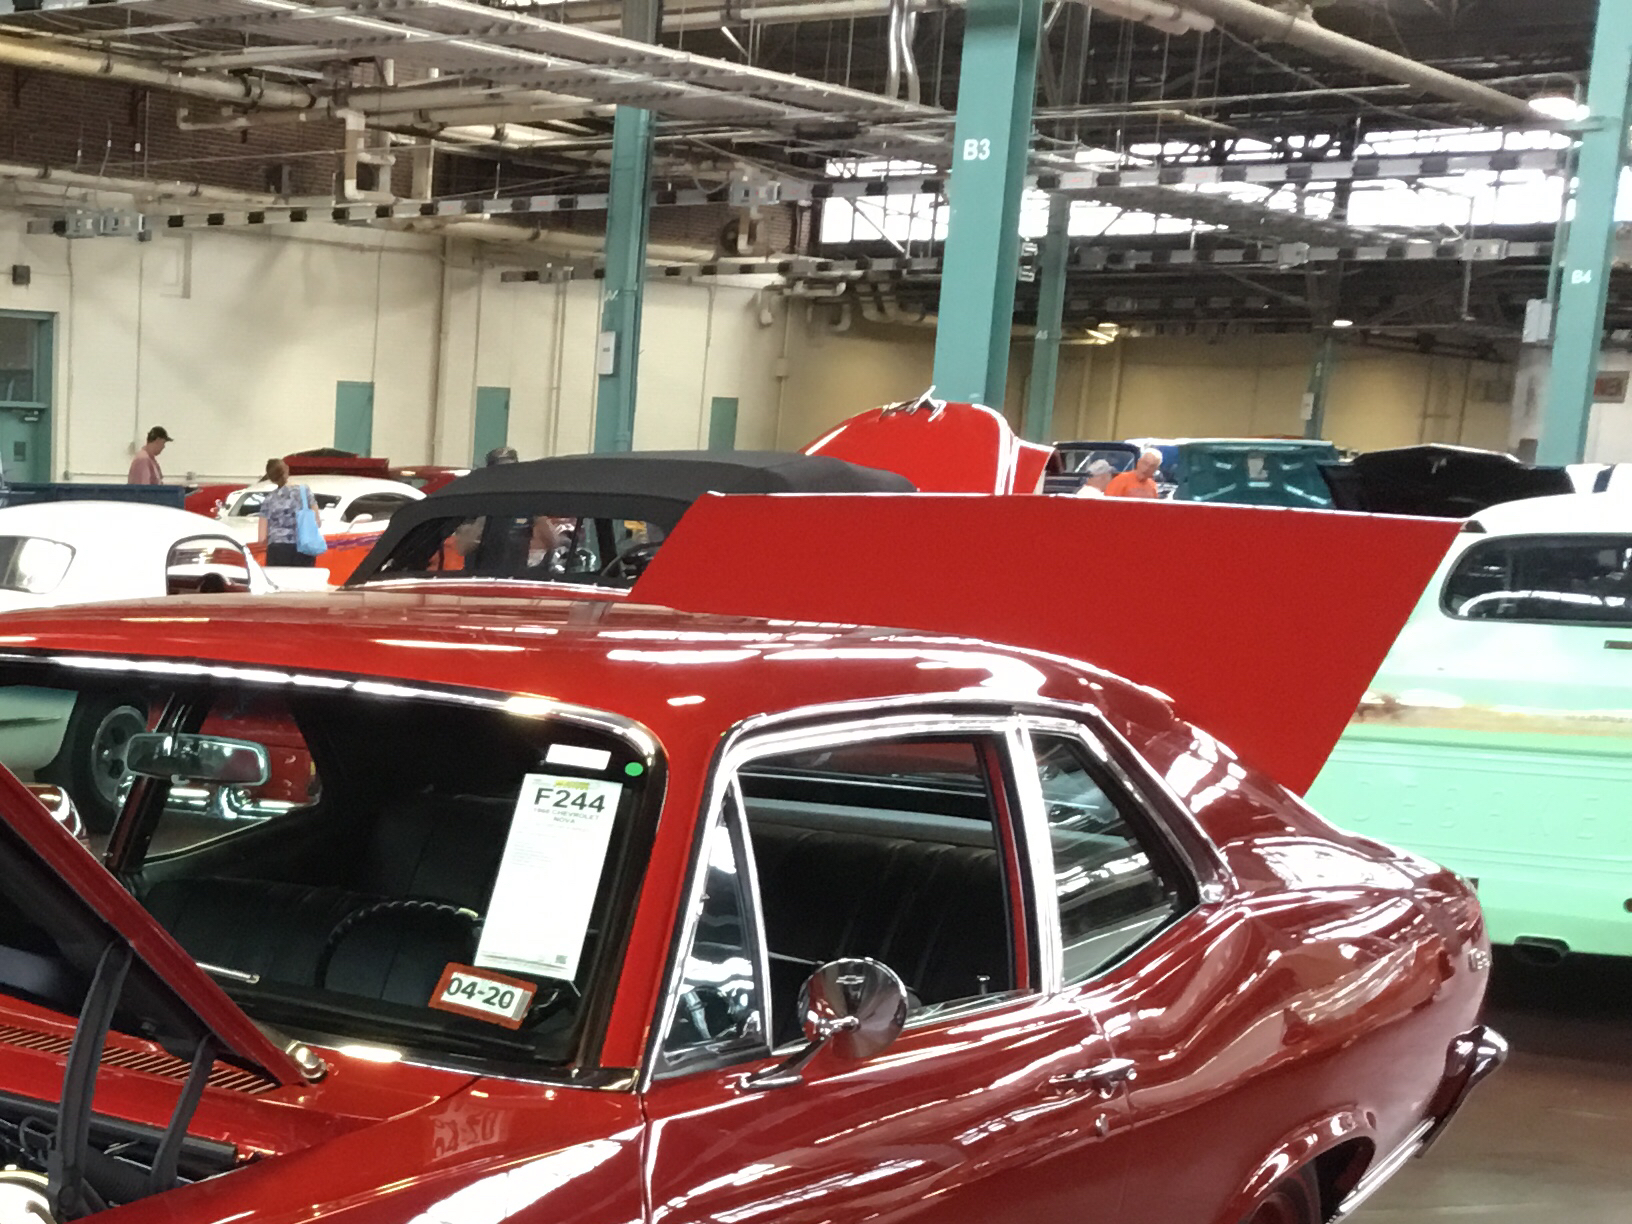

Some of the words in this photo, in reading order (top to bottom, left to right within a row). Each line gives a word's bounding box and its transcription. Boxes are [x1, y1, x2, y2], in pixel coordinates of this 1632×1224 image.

[963, 138, 990, 161] B3
[1571, 269, 1592, 284] B4
[534, 788, 605, 813] F244
[553, 816, 576, 824] NOVA
[447, 977, 515, 1009] 04-20
